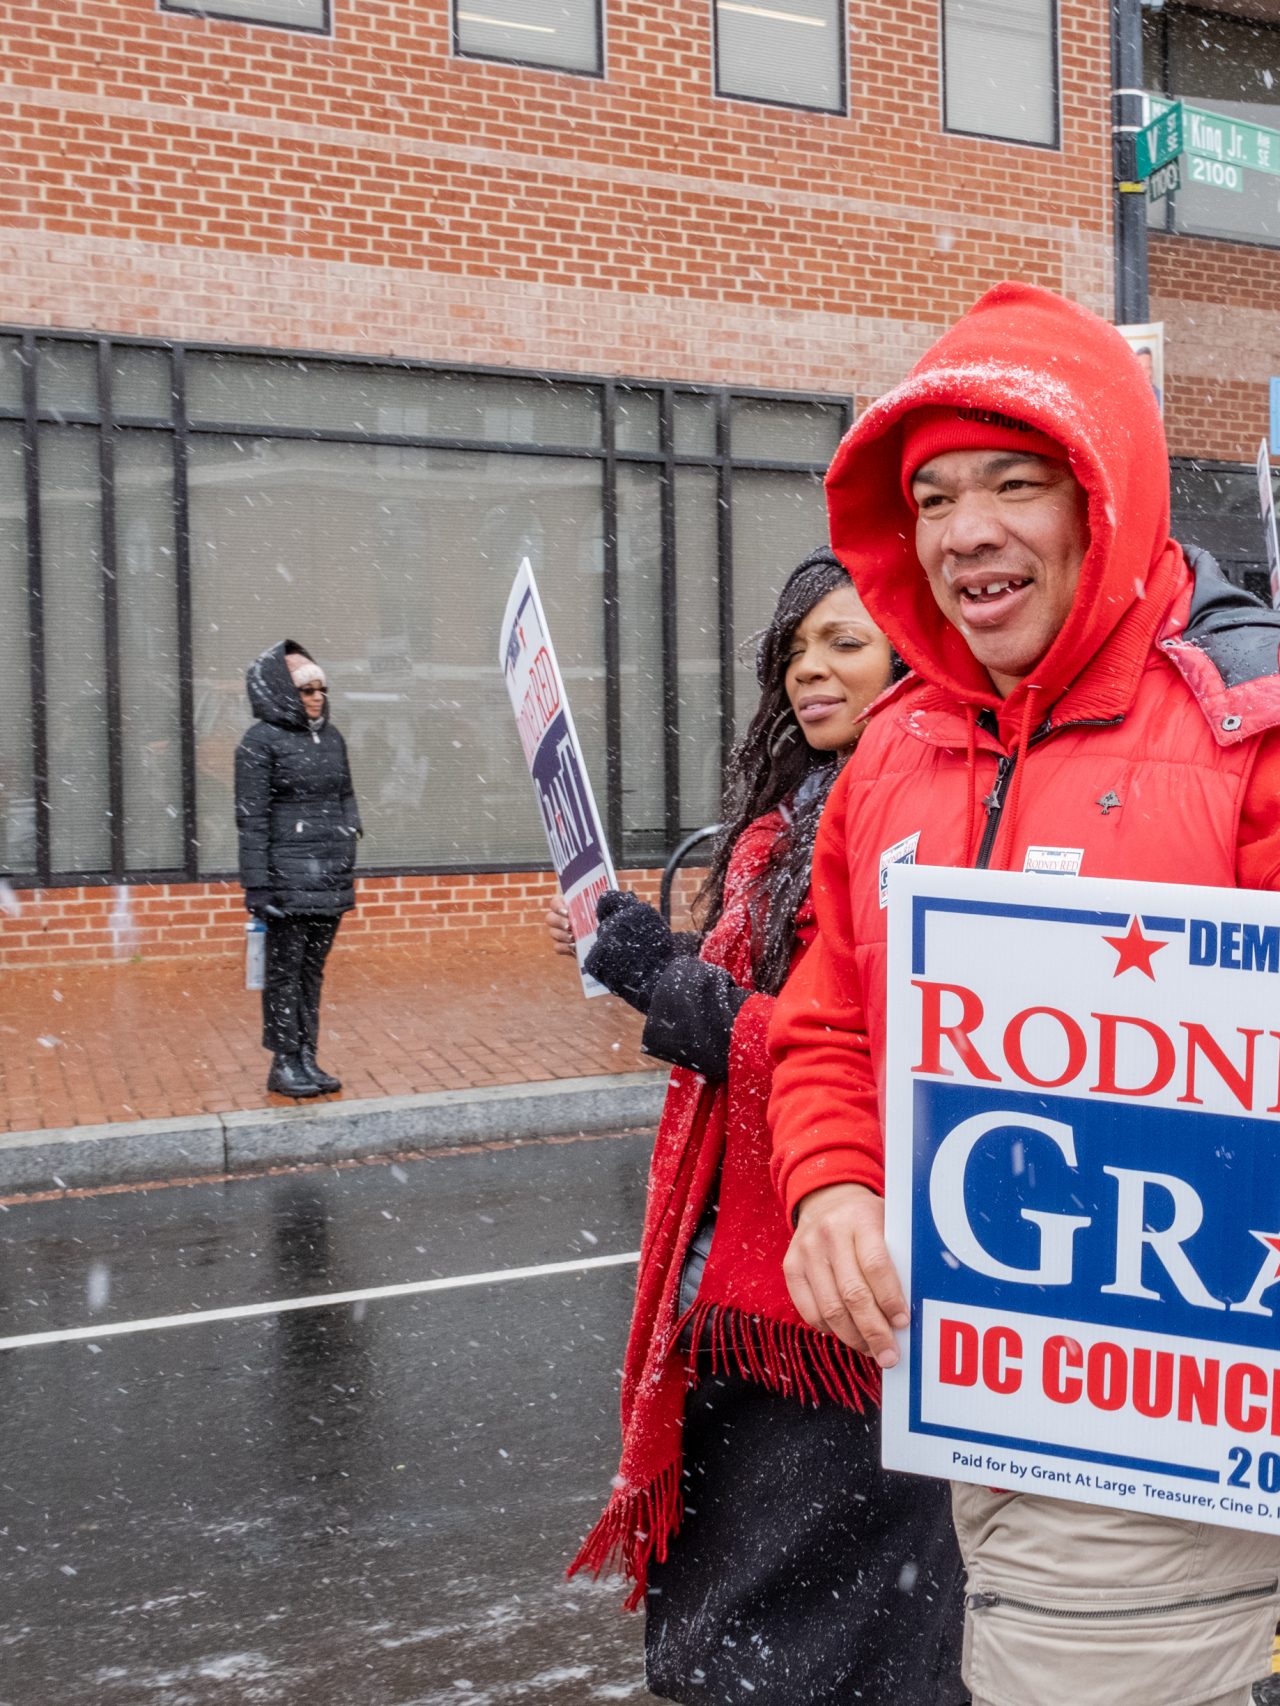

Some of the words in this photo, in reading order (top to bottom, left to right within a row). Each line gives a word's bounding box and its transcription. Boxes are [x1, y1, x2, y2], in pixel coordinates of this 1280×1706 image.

[1146, 126, 1158, 163] V
[1191, 114, 1222, 160] King
[1227, 125, 1247, 160] Jr.
[1192, 158, 1237, 188] 2100
[1258, 149, 1271, 166] SE
[1061, 860, 1079, 871] RED
[939, 1318, 1023, 1395] DC
[953, 1452, 982, 1468] Paid
[986, 1456, 1006, 1472] for
[1010, 1461, 1027, 1479] by
[1031, 1466, 1071, 1484] Grant
[1075, 1472, 1091, 1488] At
[1096, 1476, 1136, 1496] Large
[1143, 1484, 1215, 1509] Treasurer,
[1220, 1497, 1253, 1514] Cine
[1258, 1503, 1273, 1518] D.
